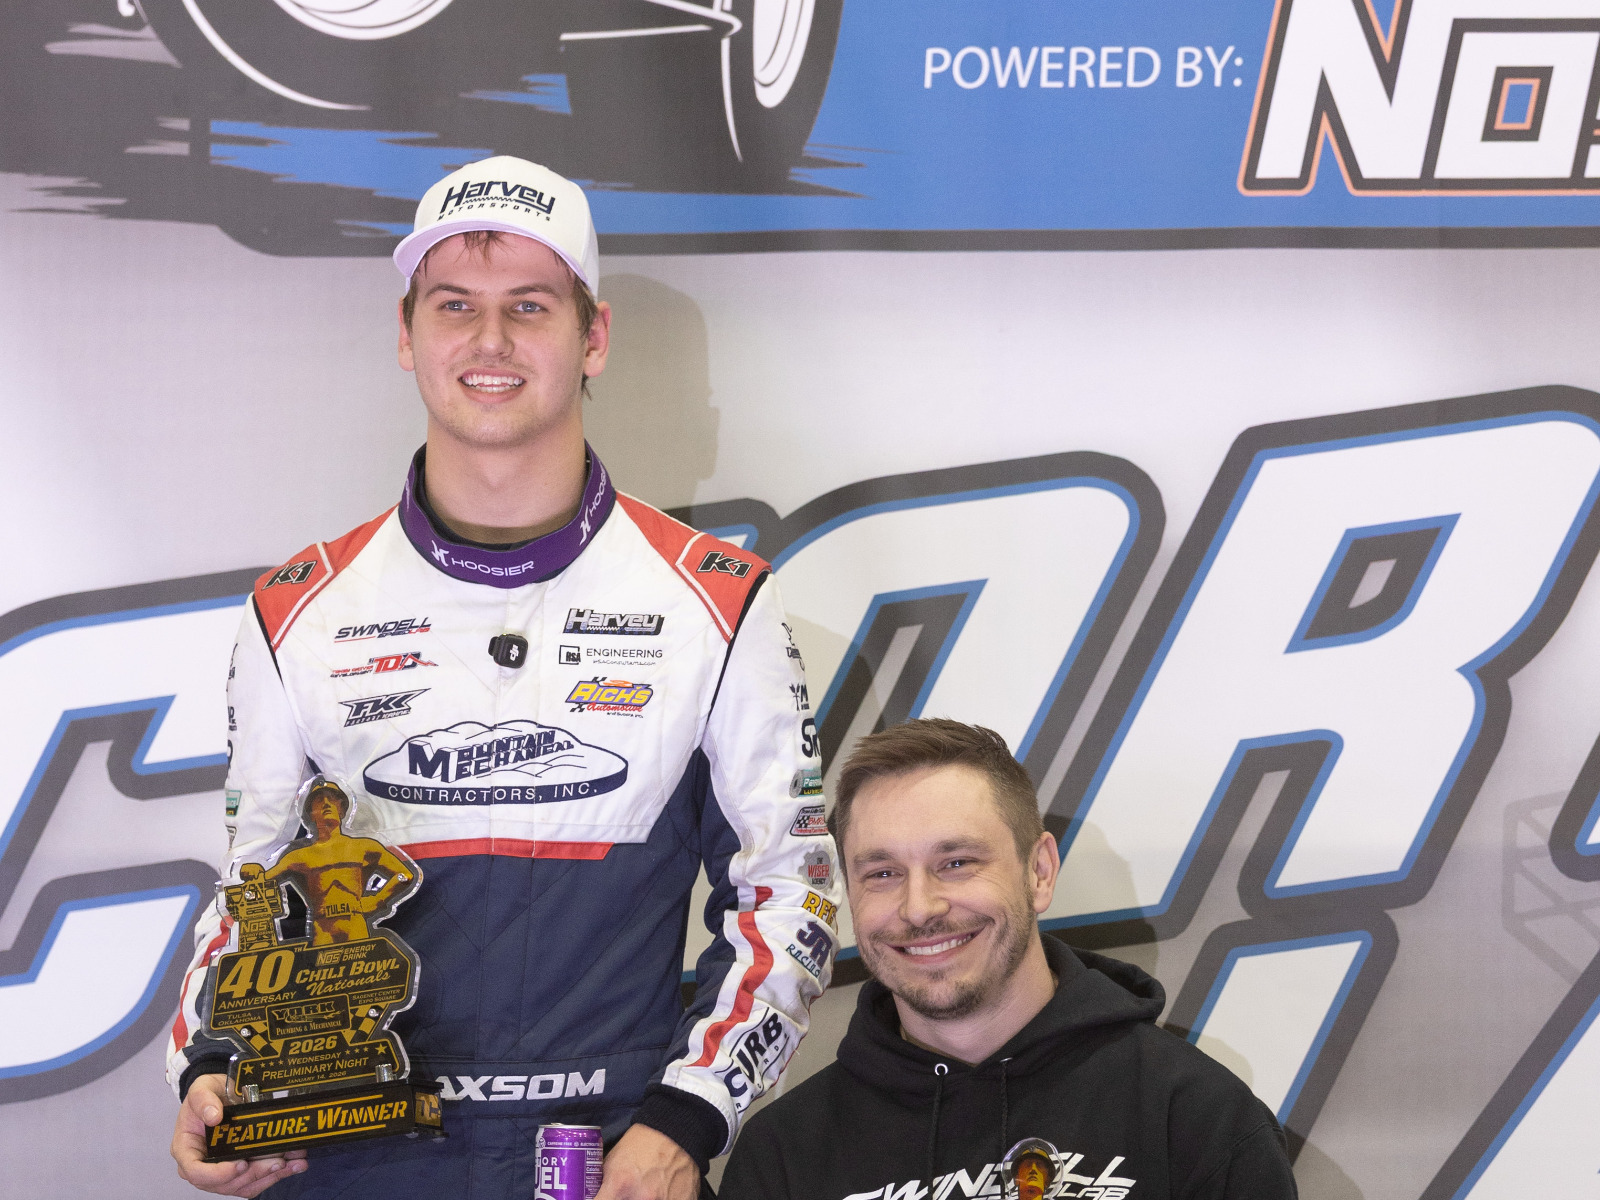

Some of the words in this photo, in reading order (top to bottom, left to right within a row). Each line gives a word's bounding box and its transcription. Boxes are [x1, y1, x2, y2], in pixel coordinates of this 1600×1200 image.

[923, 46, 1162, 89] POWERED
[1175, 45, 1244, 88] BY:
[1237, 0, 1600, 197] NO
[439, 181, 556, 214] Harvey
[437, 202, 551, 222] MOTORSPORTS
[451, 557, 535, 577] HOOSIER
[696, 551, 754, 578] K1
[261, 561, 318, 591] K1
[334, 616, 432, 639] SWINDELL
[564, 608, 663, 634] Harvey
[586, 648, 663, 659] ENGINEERING
[388, 785, 543, 802] CONTRACTORS,
[553, 782, 598, 798] INC.
[807, 864, 830, 878] WISER
[326, 902, 351, 917] TULSA
[342, 952, 368, 962] DRINK
[344, 944, 377, 955] ENERGY
[295, 966, 346, 984] CHILI
[349, 958, 400, 976] BOWL
[306, 970, 390, 996] Nationals
[218, 991, 297, 1010] ANNIVERSARY
[218, 1016, 261, 1027] OKLAHOMA
[227, 1012, 252, 1020] TULSA
[288, 1035, 338, 1055] 2026
[723, 1012, 783, 1098] CURB
[288, 1052, 342, 1065] WEDNESDAY
[262, 1063, 333, 1081] PRELIMINARY
[335, 1057, 369, 1070] NIGHT
[210, 1115, 310, 1147] FEATURE
[317, 1100, 409, 1131] WINNER
